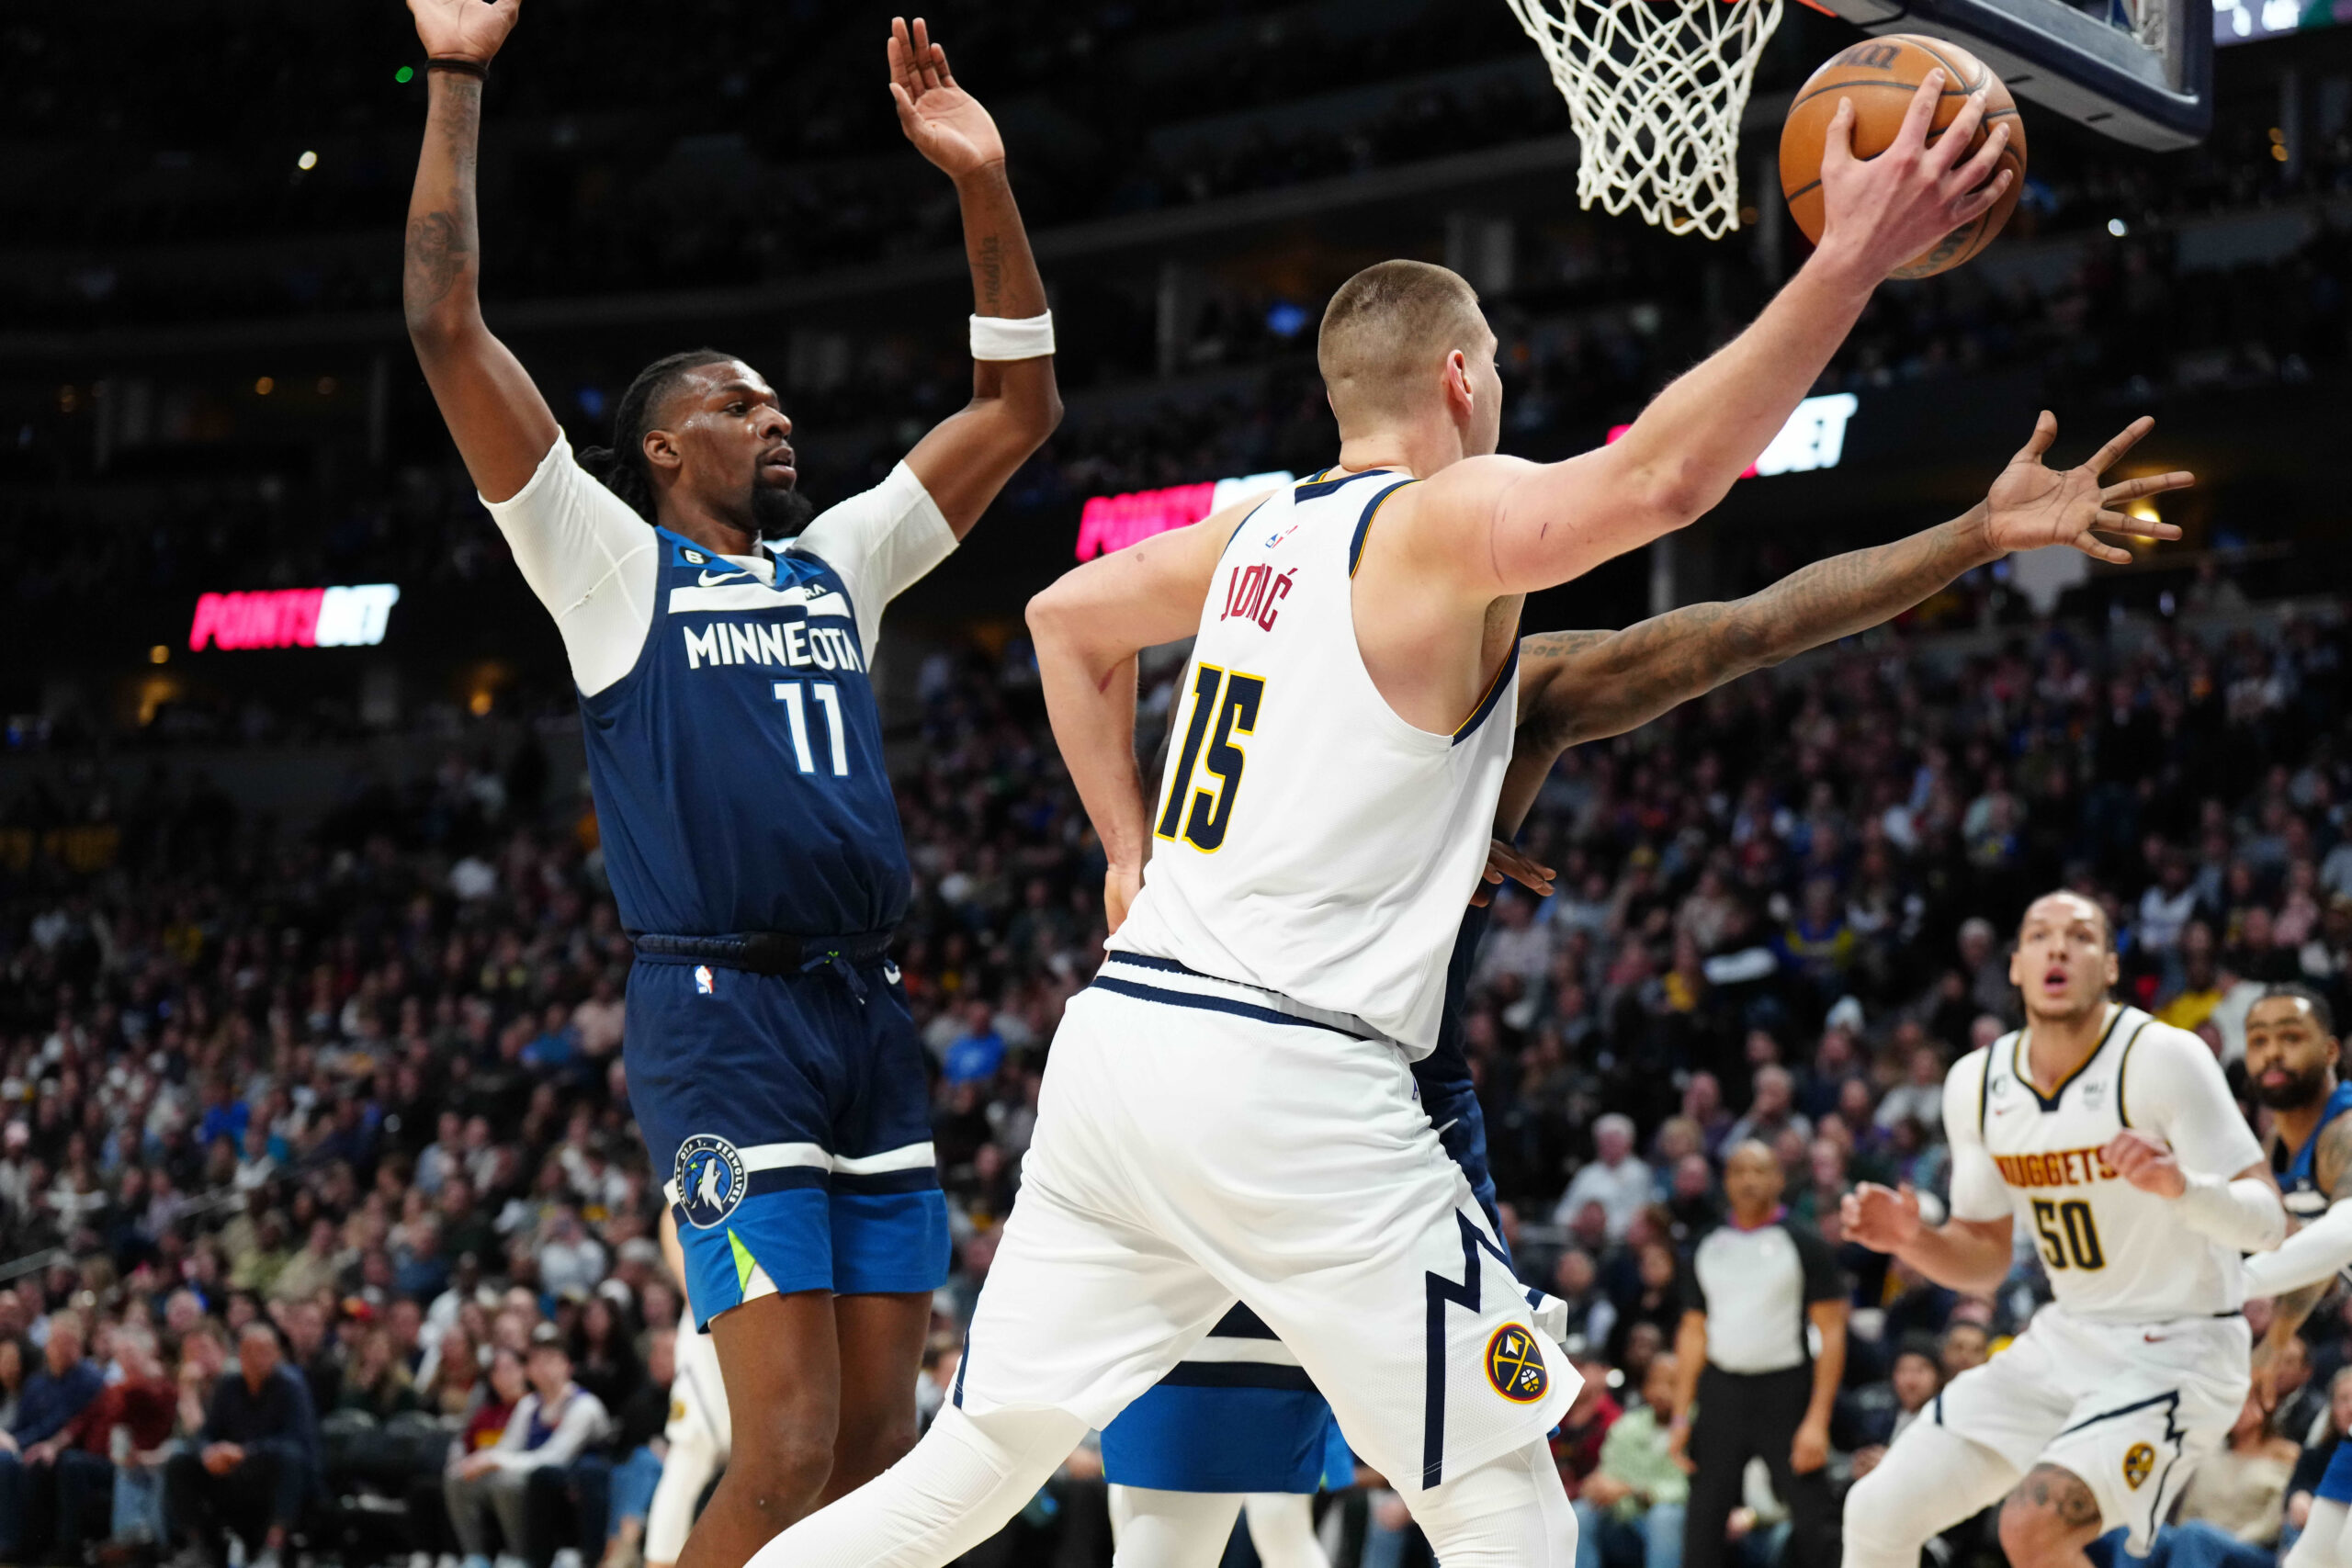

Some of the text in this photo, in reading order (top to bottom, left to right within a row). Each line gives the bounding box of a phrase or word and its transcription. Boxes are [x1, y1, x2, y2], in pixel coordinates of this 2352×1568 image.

[1220, 563, 1298, 633] JOIĆ
[684, 620, 864, 673] MINNEOTA
[771, 680, 850, 777] 11
[1153, 661, 1266, 854] 15
[2031, 1197, 2106, 1270] 50
